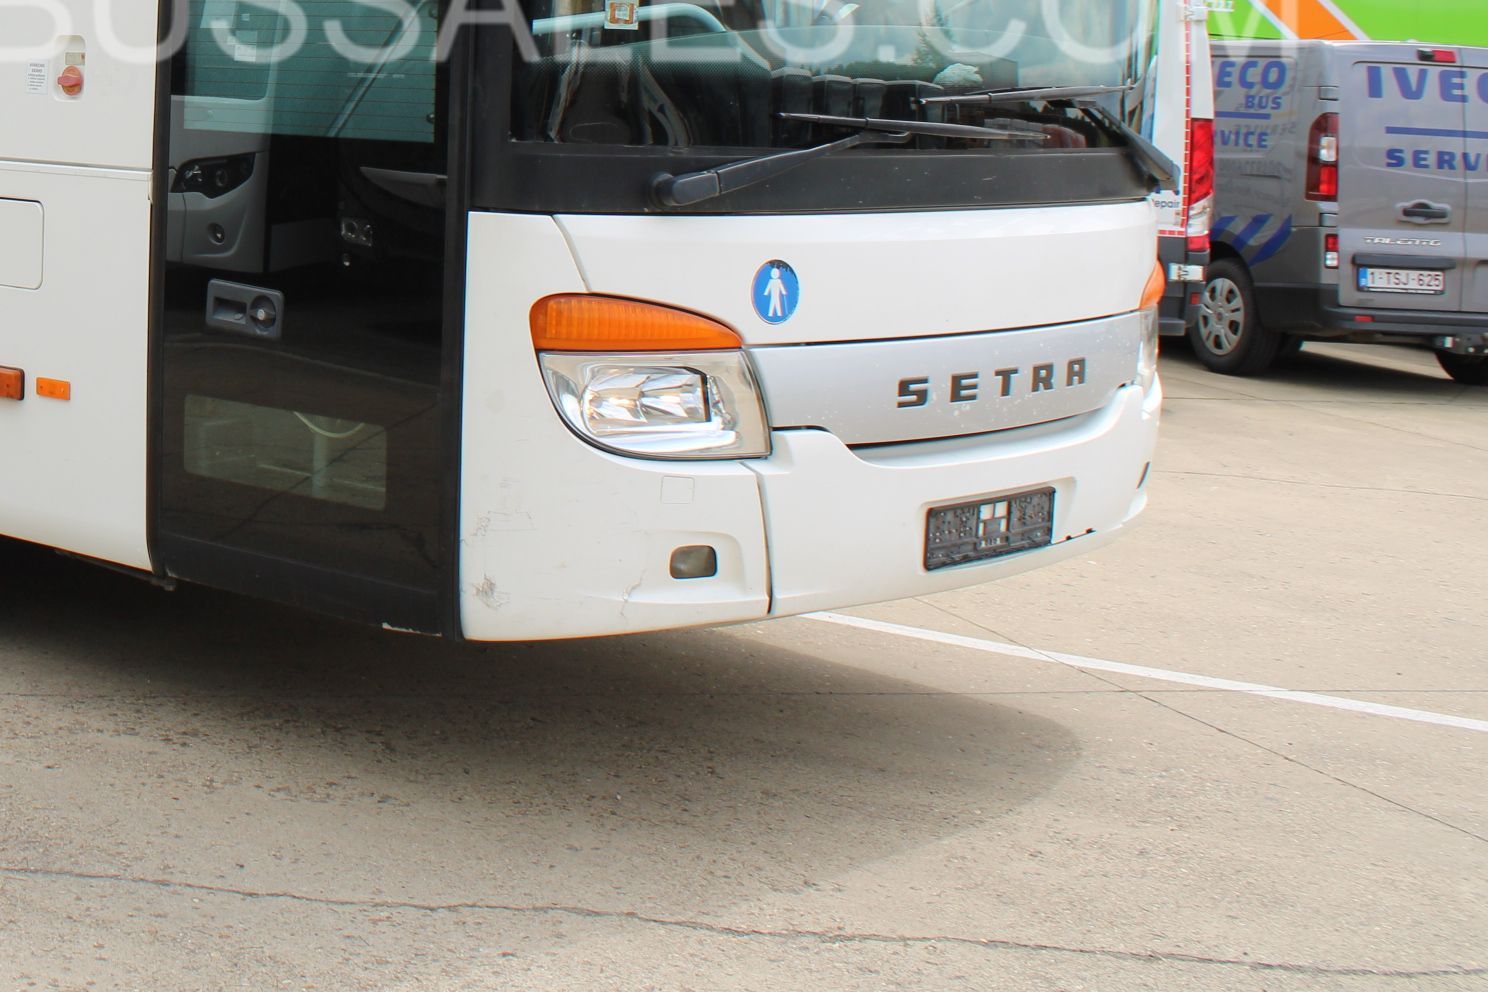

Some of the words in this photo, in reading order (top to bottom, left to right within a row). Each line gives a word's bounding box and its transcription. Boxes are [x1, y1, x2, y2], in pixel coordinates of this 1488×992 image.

[1244, 93, 1282, 110] BUS
[1369, 271, 1442, 287] 1-TSJ-625
[896, 357, 1086, 409] SETRA
